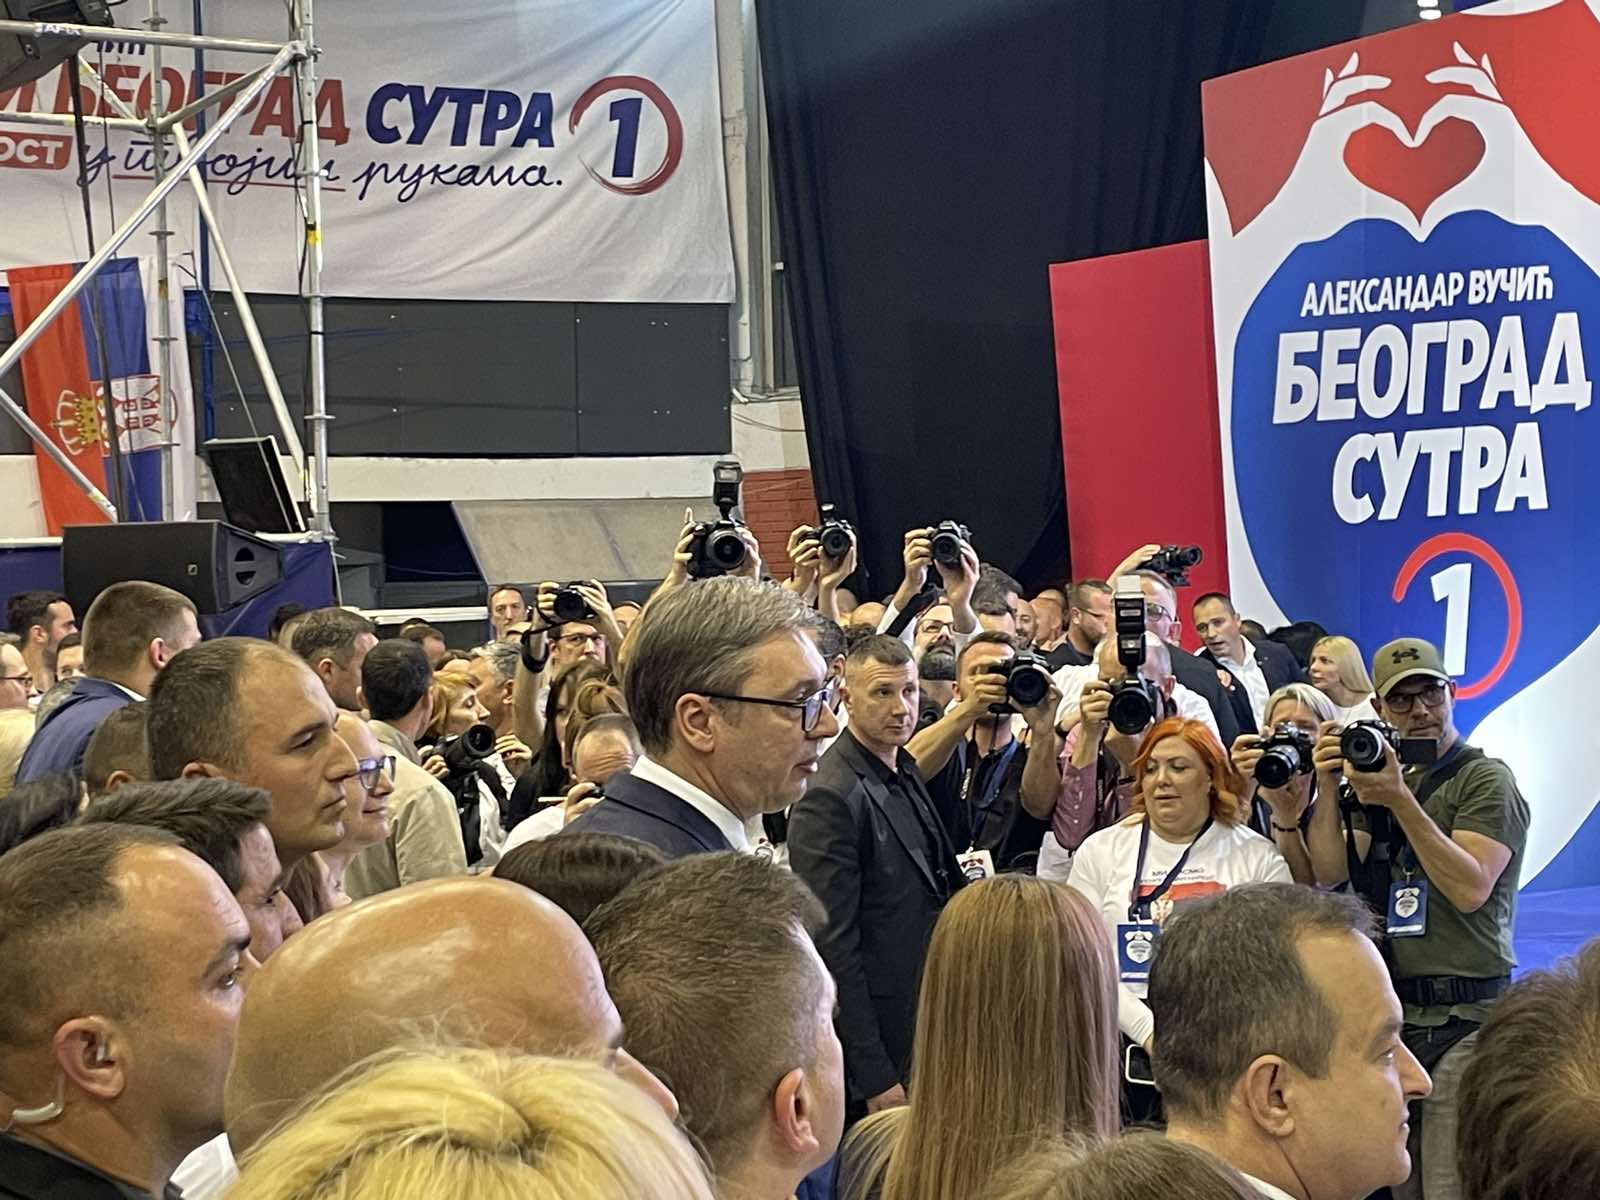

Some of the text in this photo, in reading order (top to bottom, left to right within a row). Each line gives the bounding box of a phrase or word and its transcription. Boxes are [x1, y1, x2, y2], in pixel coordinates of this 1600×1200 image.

[365, 83, 555, 148] СУТРА
[609, 97, 643, 178] 1
[1300, 265, 1554, 317] АЛЕКСАНДАР ВУЧИЋ
[1272, 311, 1592, 425] БЕОГРАД
[1332, 421, 1549, 525] СУТРА
[1430, 562, 1472, 677] 1
